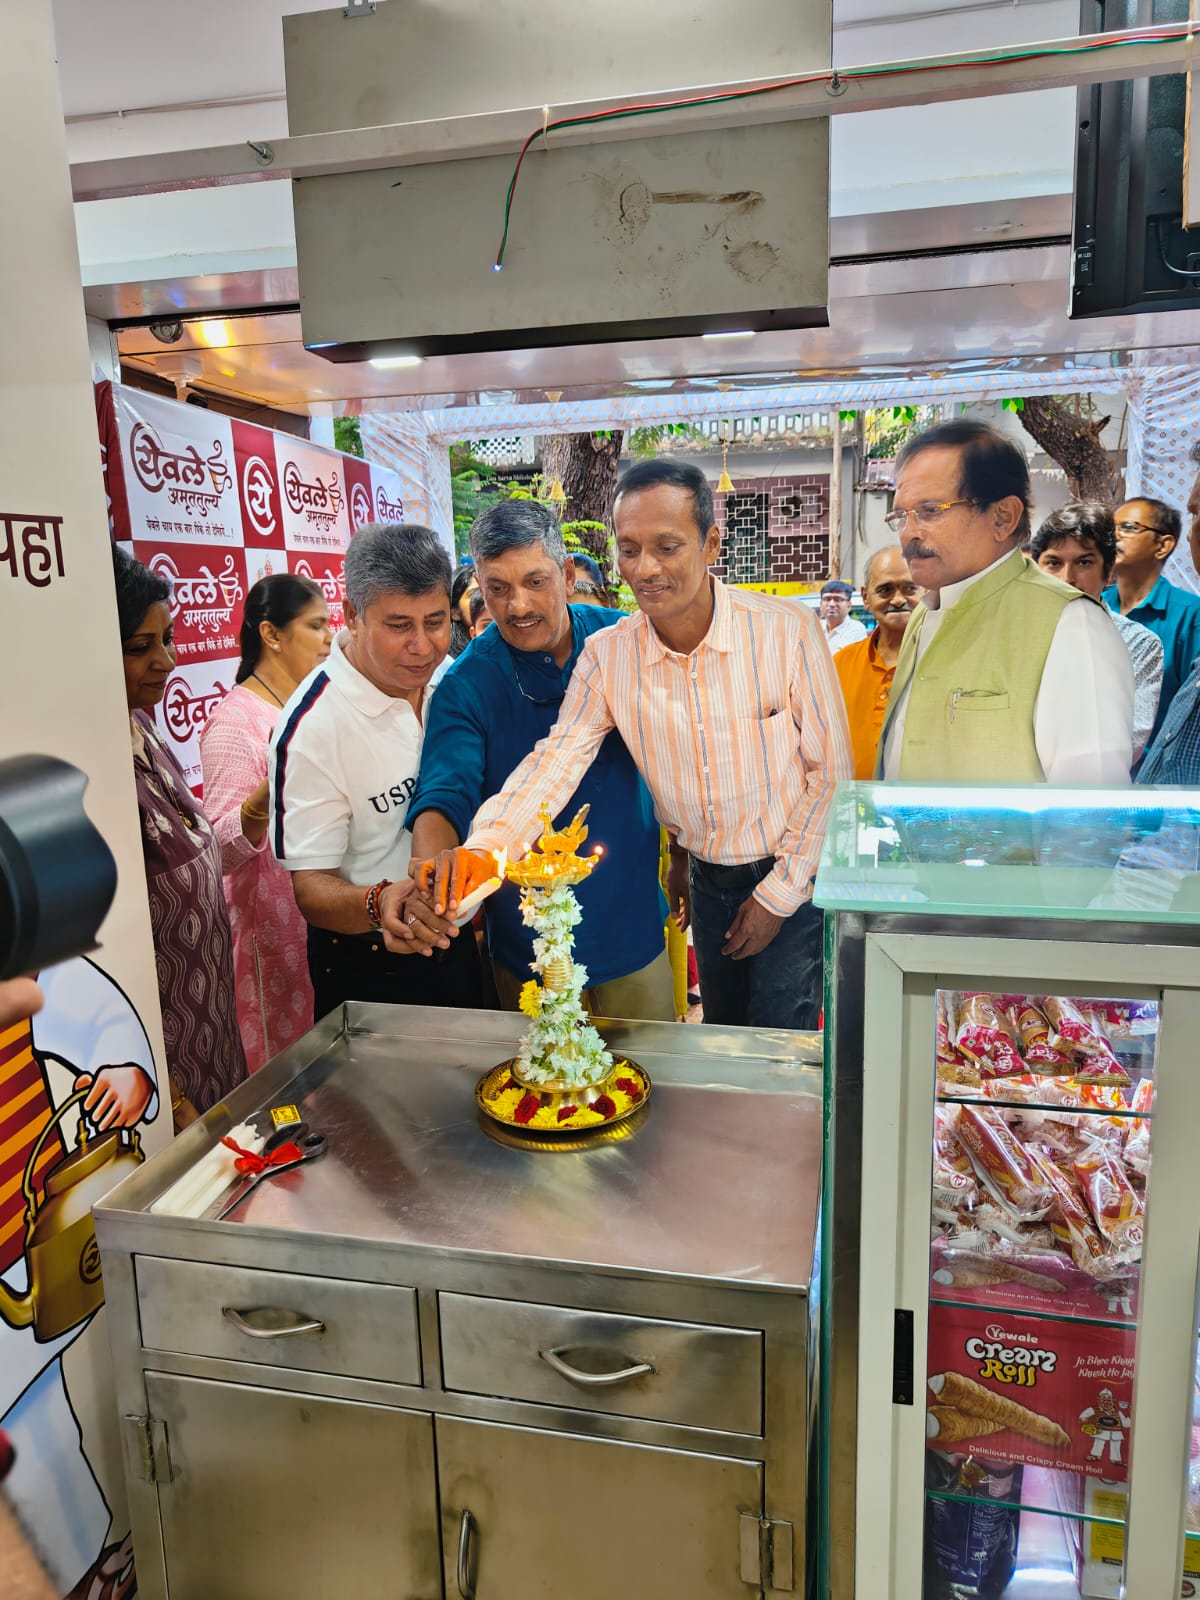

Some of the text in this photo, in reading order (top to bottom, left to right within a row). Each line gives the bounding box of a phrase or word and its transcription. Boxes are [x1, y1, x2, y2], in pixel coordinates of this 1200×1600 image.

[133, 430, 206, 488] येवले
[168, 487, 221, 517] अमृततुल्य
[285, 468, 328, 510] येवले
[182, 607, 233, 633] अमृततुल्य
[987, 1325, 1039, 1345] Yewale
[965, 1337, 1057, 1372] Cream
[980, 1358, 1036, 1387] Roll
[969, 1445, 1104, 1475] Delicious and Crispy Cream Roll
